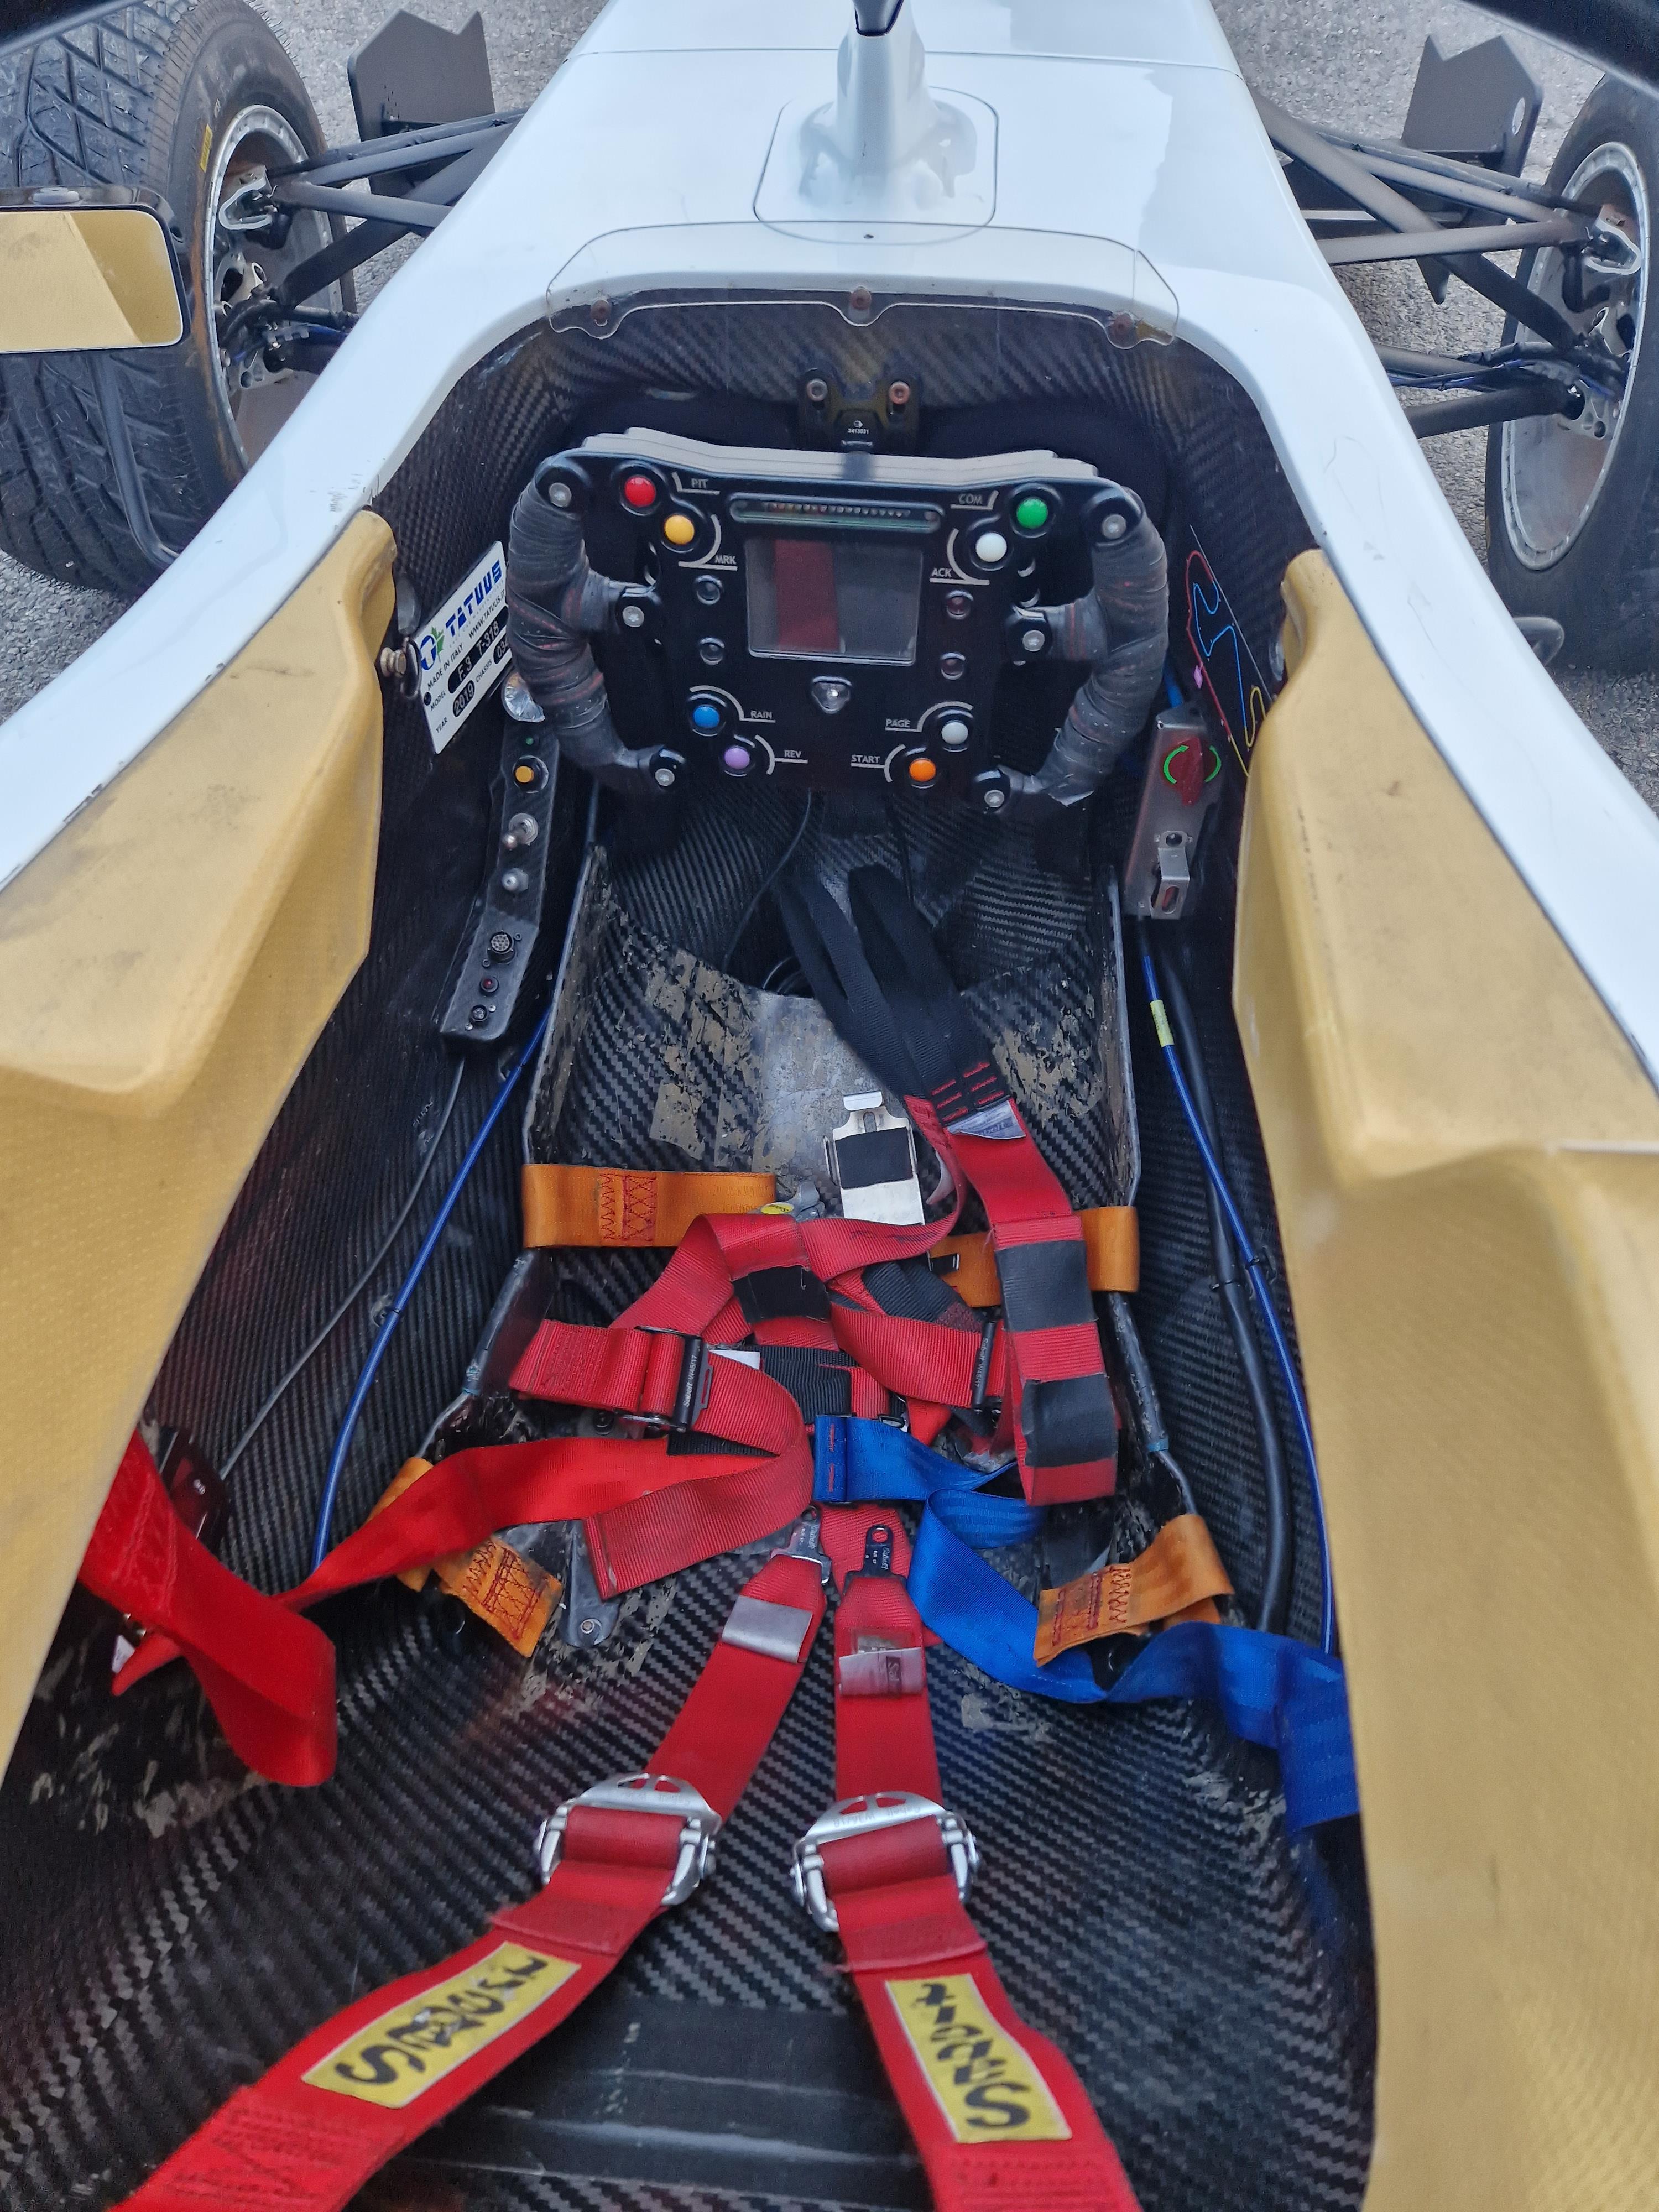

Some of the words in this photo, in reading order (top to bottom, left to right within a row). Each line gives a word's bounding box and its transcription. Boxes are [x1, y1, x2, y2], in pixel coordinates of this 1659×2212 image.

[692, 478, 708, 488] PIT
[959, 494, 983, 504] COM
[714, 555, 737, 565] MRK
[931, 567, 952, 577] ACK
[445, 559, 502, 637] TATUUS
[468, 589, 506, 639] WWW.TATUUS.IT
[427, 667, 443, 691] MADE
[444, 659, 450, 671] IN
[451, 643, 463, 662] ITALY
[476, 658, 492, 683] CHASSIS
[430, 690, 446, 712] MODEL
[453, 682, 474, 714] 2019
[750, 710, 773, 719] RAIN
[435, 717, 448, 733] YEAR
[885, 718, 911, 728] PAGE
[784, 749, 802, 758] REV
[851, 754, 881, 764] START
[683, 1381, 693, 1408] Sabelt
